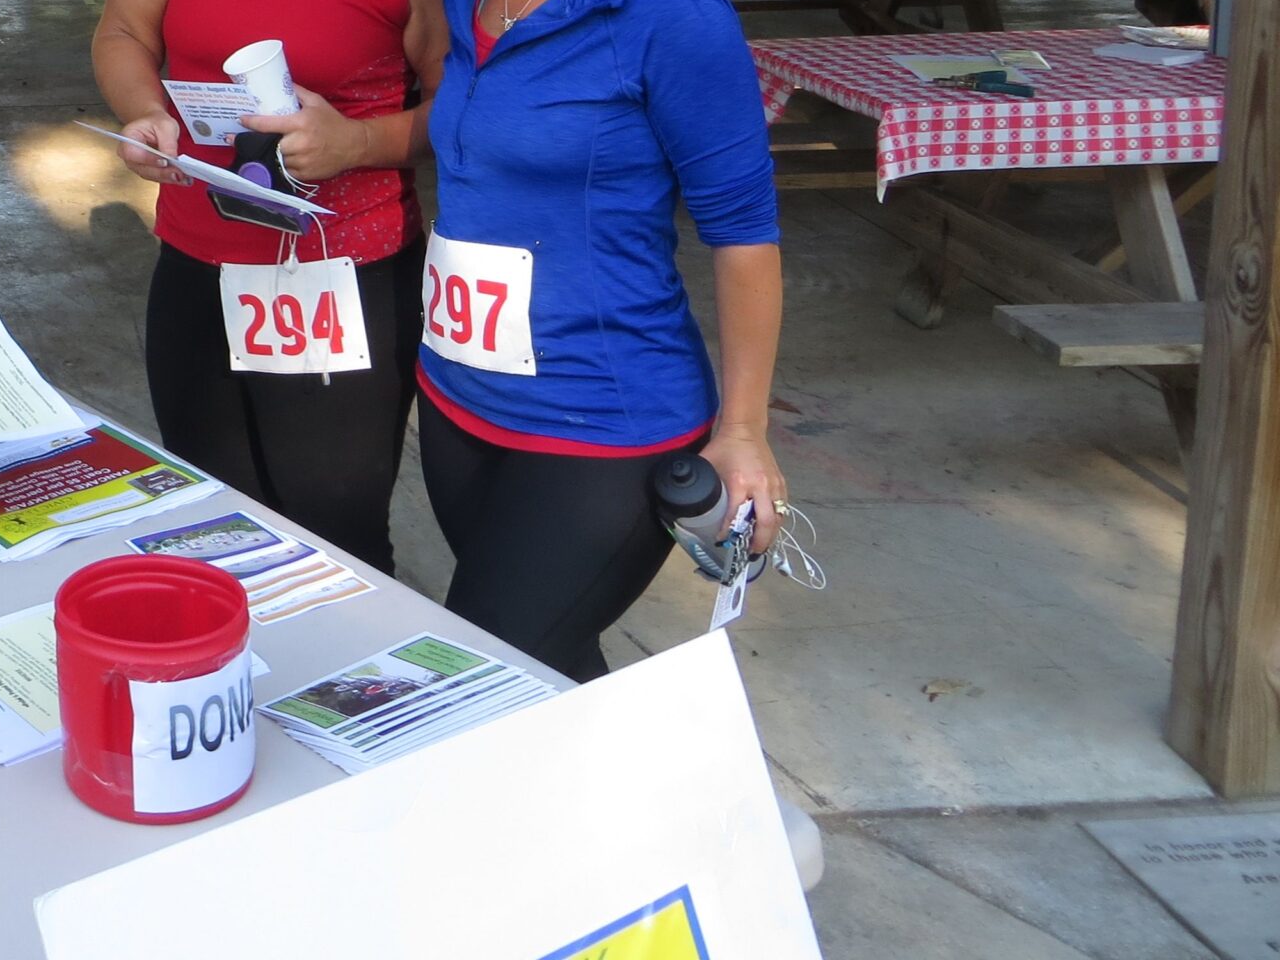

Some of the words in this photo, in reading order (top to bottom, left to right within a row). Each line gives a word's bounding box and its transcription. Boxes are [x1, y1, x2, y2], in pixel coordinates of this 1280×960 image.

[428, 263, 508, 352] 297
[238, 290, 344, 356] 294
[74, 469, 129, 489] PANCAKE
[5, 487, 73, 511] BREAKFAST
[1168, 842, 1226, 851] honor
[1232, 839, 1267, 849] and
[1140, 855, 1162, 864] to
[1168, 853, 1224, 862] those
[1230, 850, 1268, 859] who
